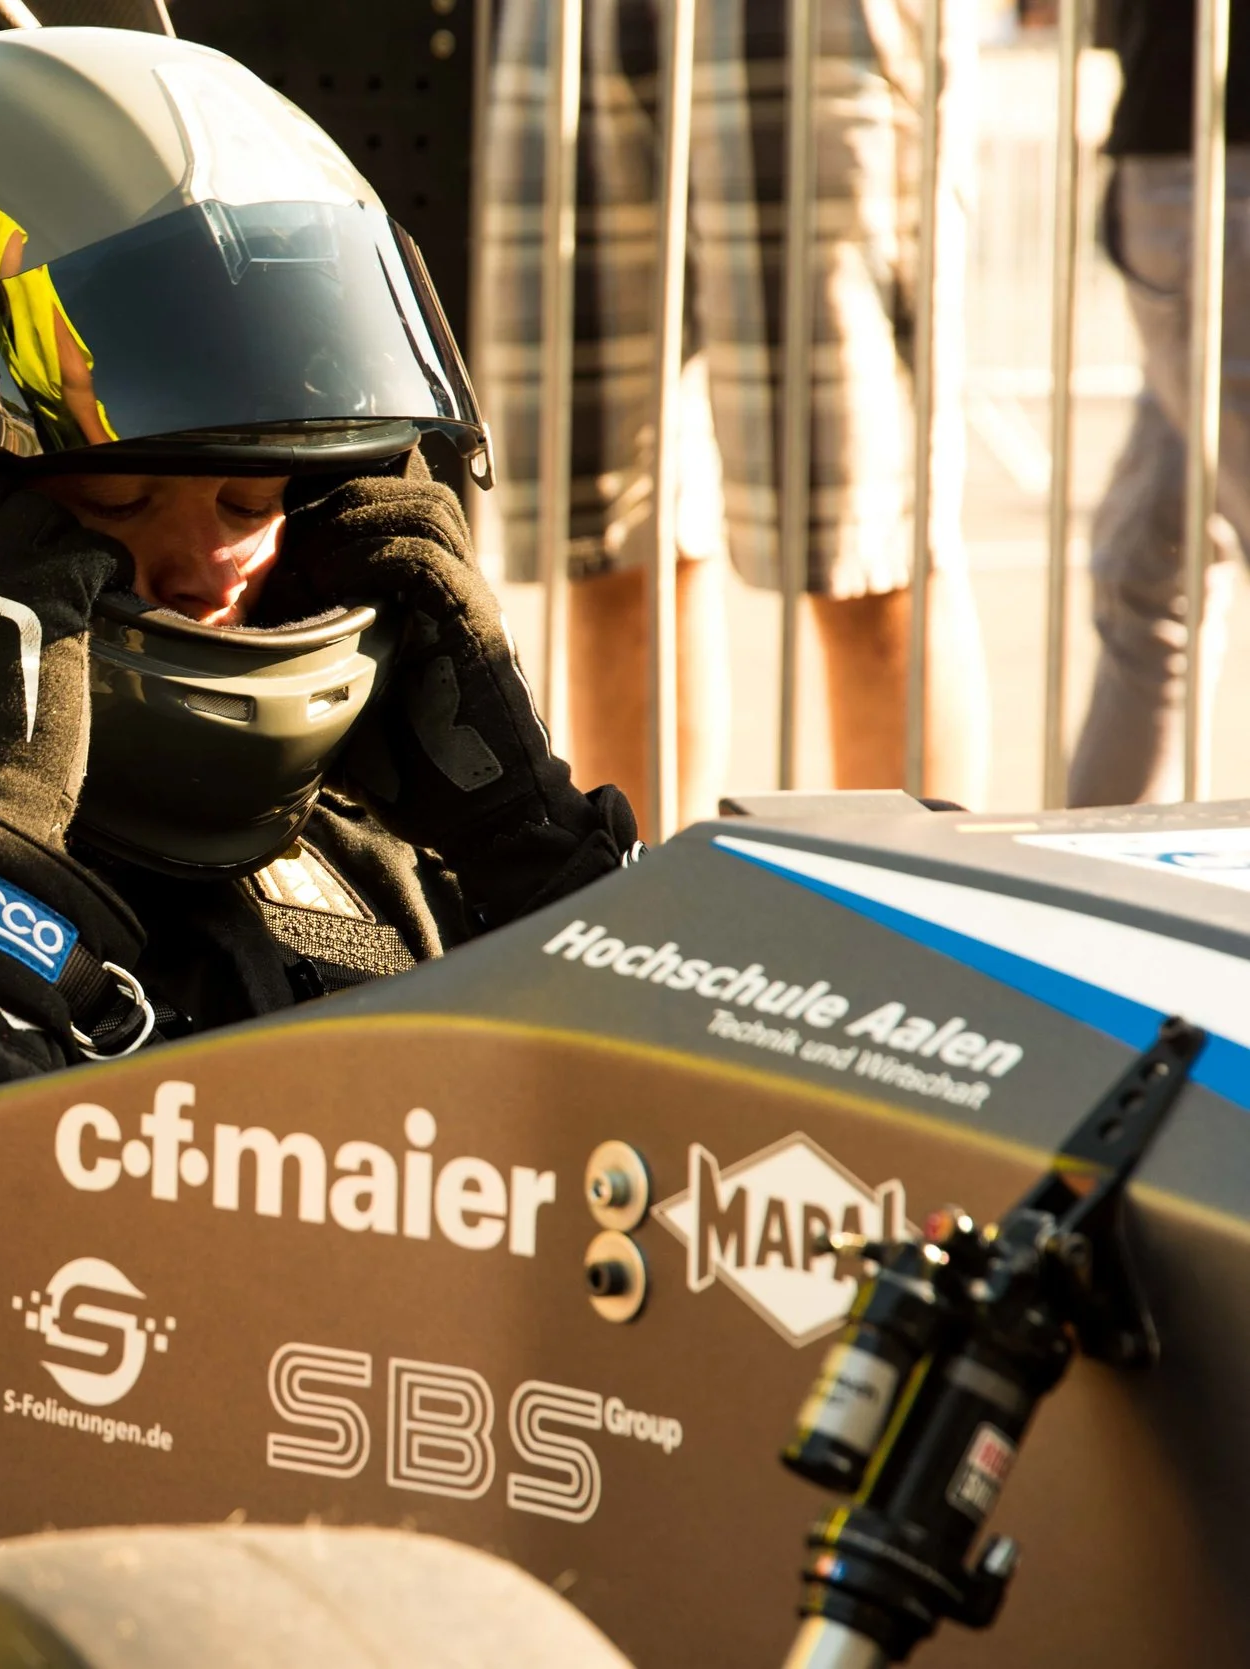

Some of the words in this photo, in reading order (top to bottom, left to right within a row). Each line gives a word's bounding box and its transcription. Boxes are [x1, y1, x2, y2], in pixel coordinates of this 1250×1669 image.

[542, 919, 850, 1029] Hochschule
[844, 1001, 1024, 1078] Aalen
[706, 1008, 803, 1056] Technik
[798, 1035, 859, 1072] und
[855, 1048, 992, 1111] Wirtschaft
[3, 1388, 174, 1452] S-Folierungen.de
[266, 1341, 603, 1525] SBS
[604, 1397, 683, 1455] Group
